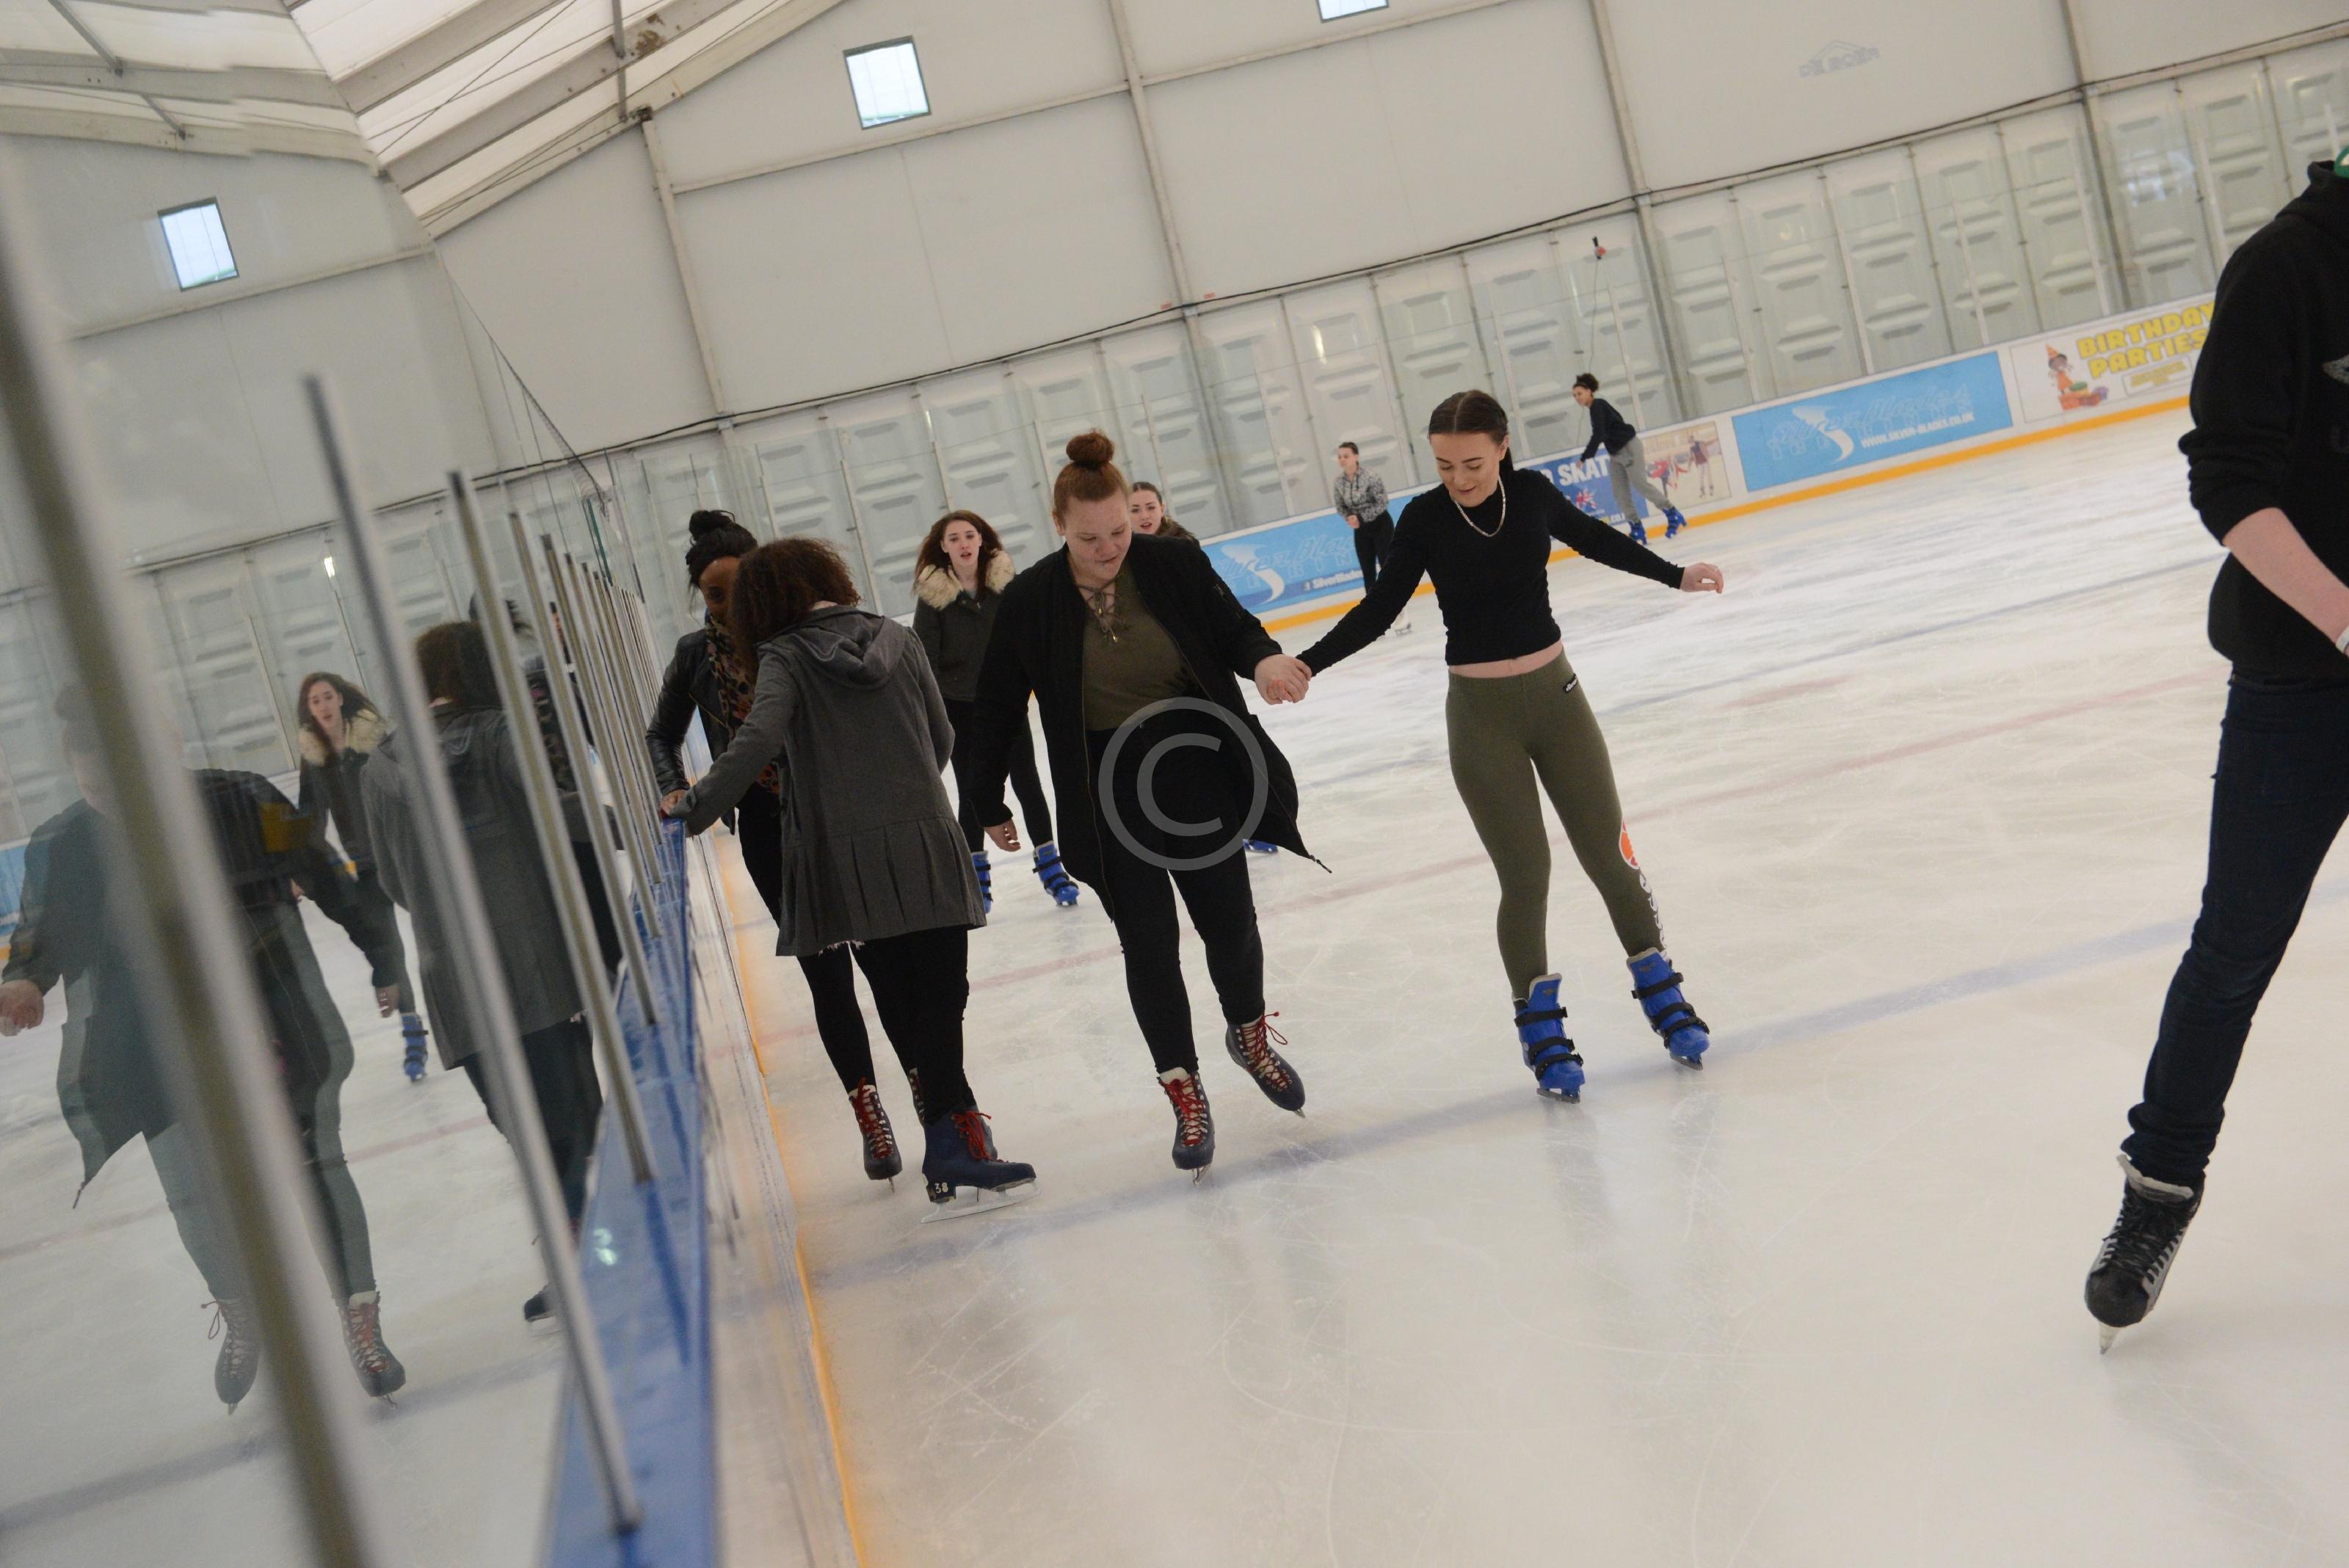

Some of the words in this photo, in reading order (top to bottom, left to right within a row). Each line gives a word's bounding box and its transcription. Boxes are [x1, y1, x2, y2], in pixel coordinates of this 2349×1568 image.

[2076, 299, 2215, 359] BIRTHDAY
[2087, 327, 2209, 380] PARTIES
[1557, 454, 1611, 487] SKAT
[934, 1182, 948, 1194] 38
